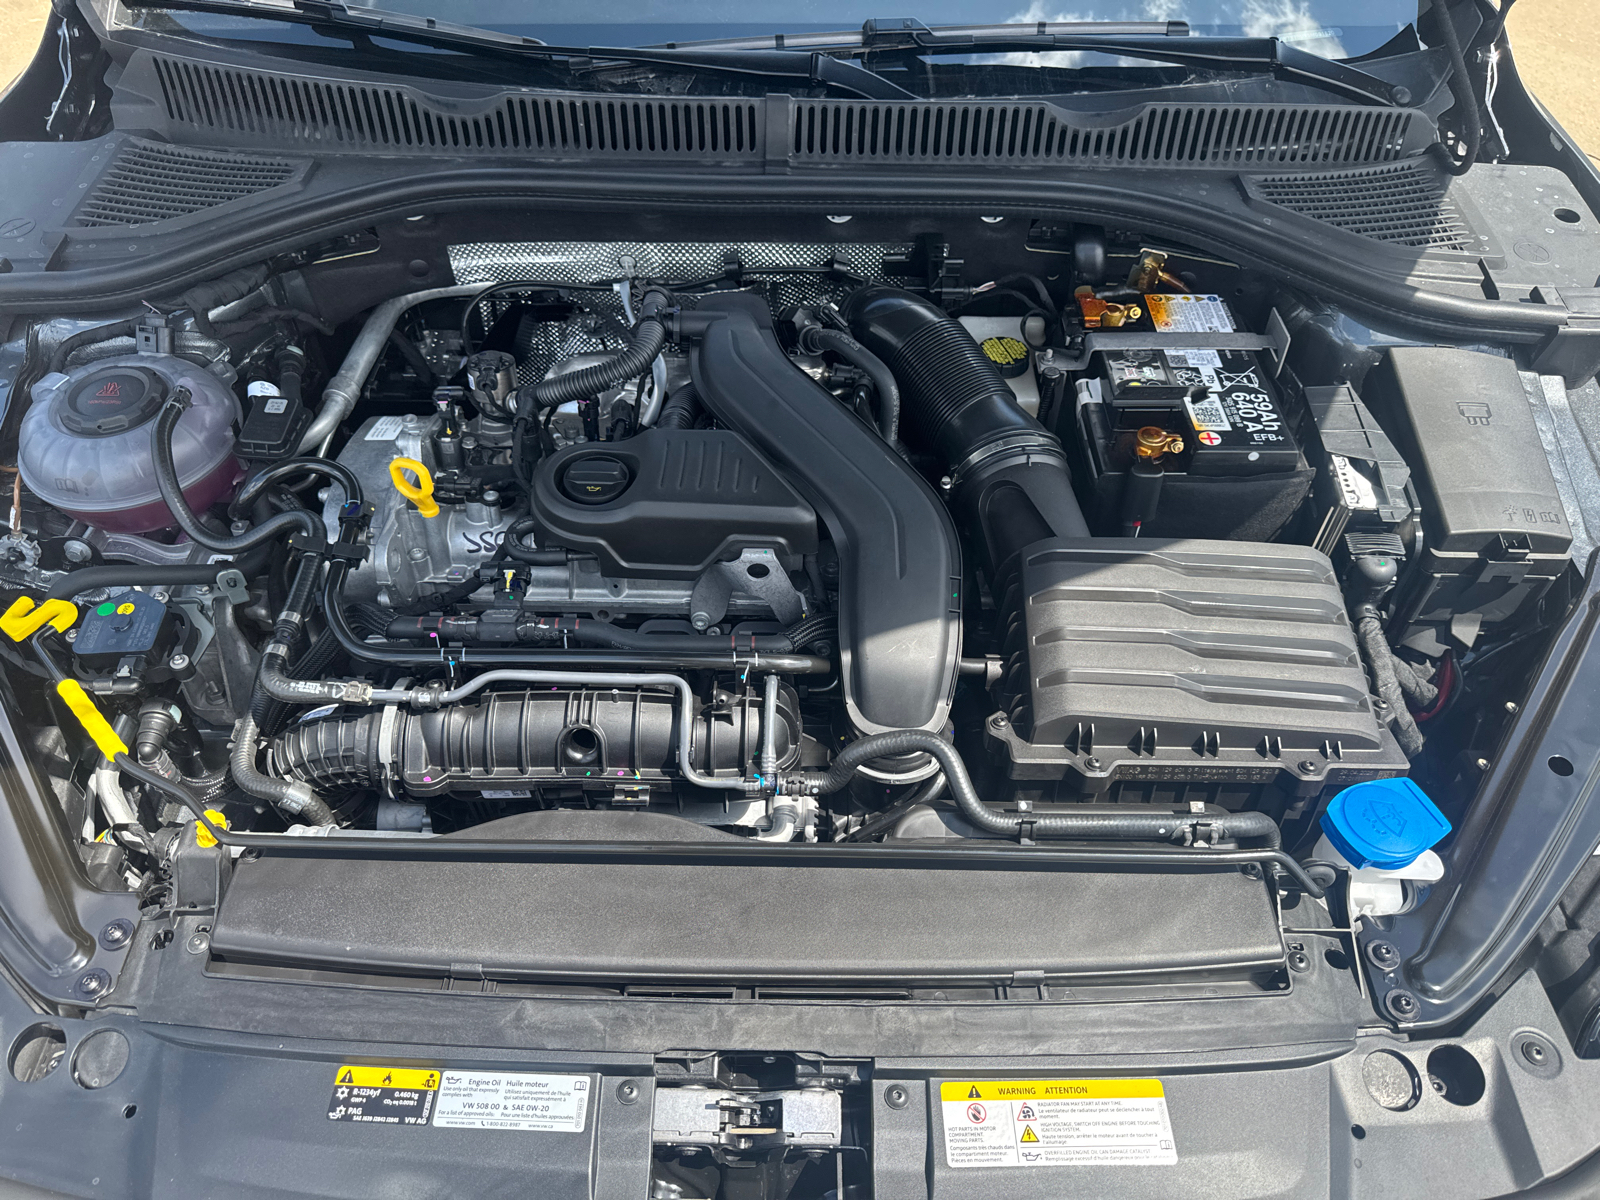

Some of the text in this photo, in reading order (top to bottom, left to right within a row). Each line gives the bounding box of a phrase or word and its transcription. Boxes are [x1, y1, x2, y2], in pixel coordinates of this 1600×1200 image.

[1204, 374, 1215, 384] Pb
[1231, 392, 1258, 418] 640
[1251, 393, 1281, 431] 59Ah
[1243, 421, 1264, 433] A
[1253, 433, 1285, 442] EFB+
[468, 1078, 502, 1088] Engine Oil
[352, 1088, 382, 1098] R-1234yf
[411, 1092, 420, 1100] kg
[997, 1086, 1088, 1096] WARNING ATTENTION
[347, 1107, 363, 1115] PAG
[476, 1102, 490, 1110] 508
[526, 1104, 550, 1112] 0W-20
[404, 1116, 417, 1124] VW
